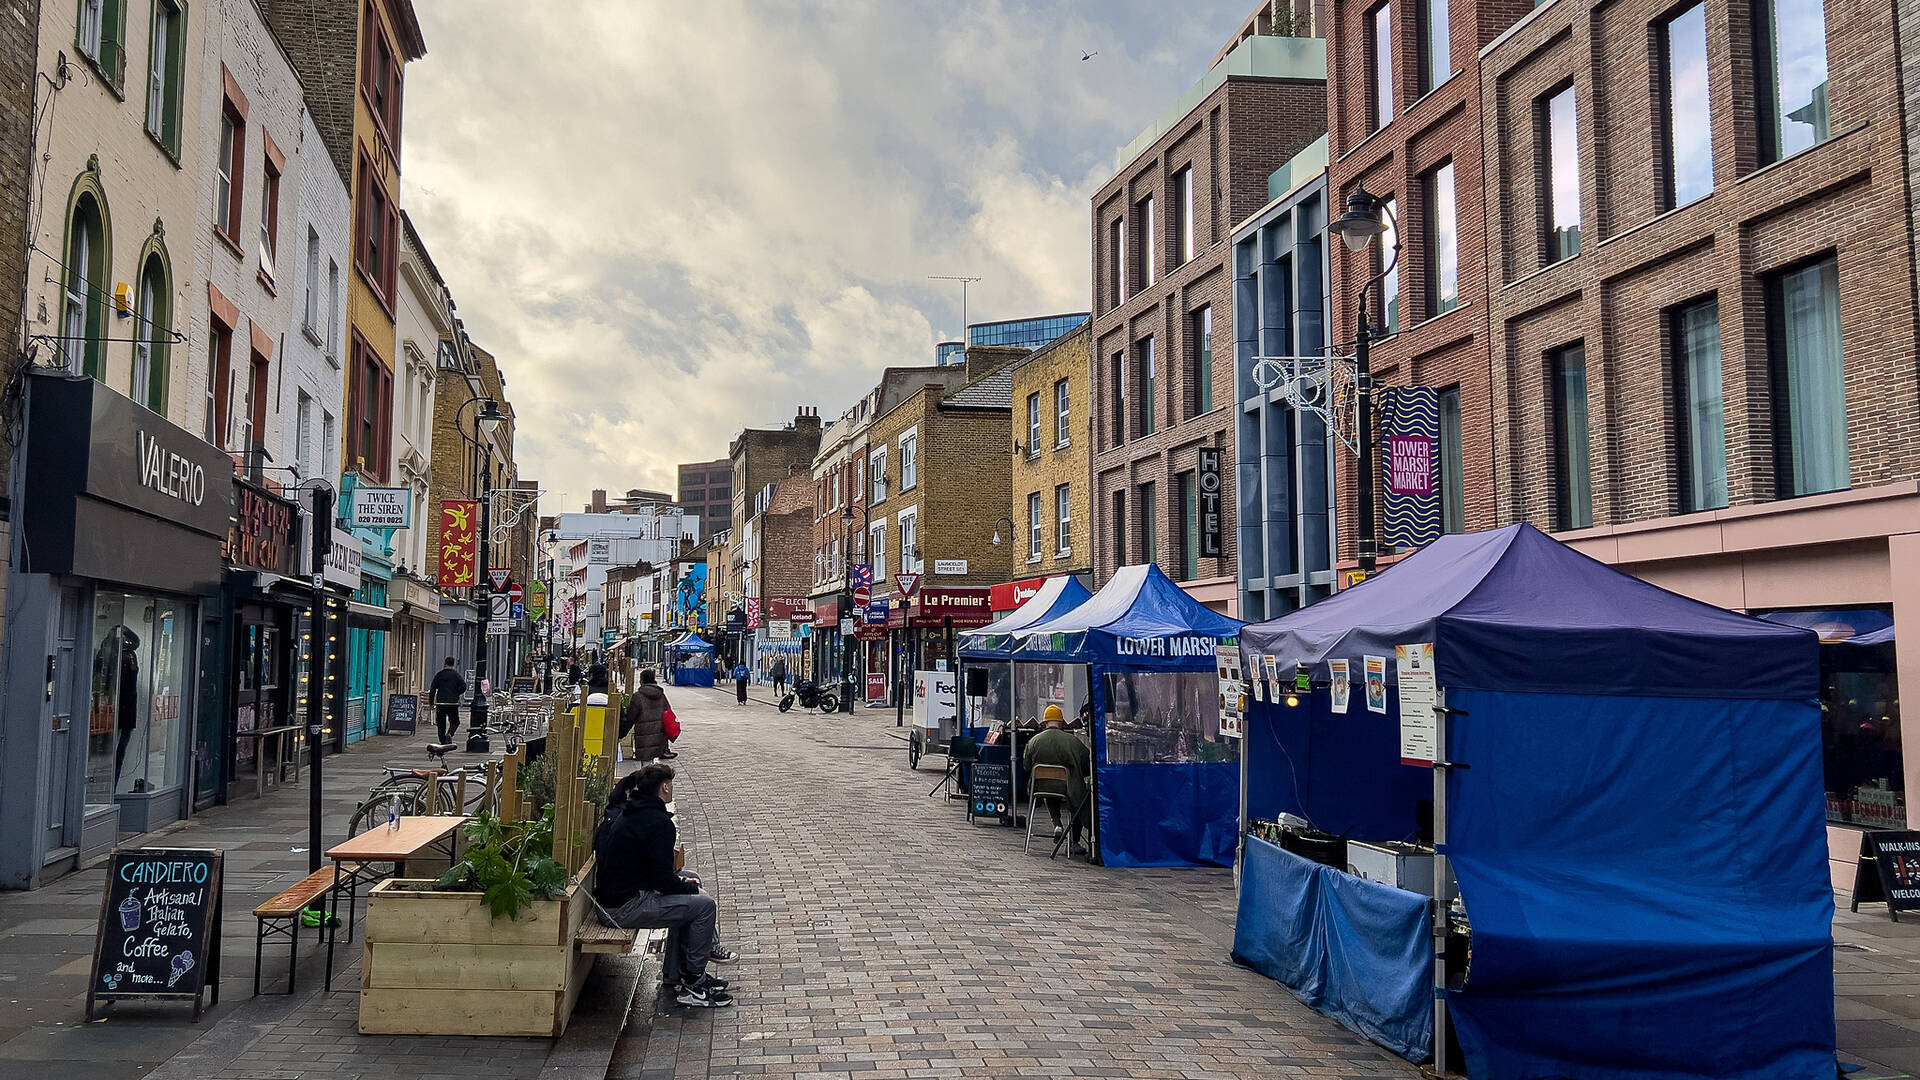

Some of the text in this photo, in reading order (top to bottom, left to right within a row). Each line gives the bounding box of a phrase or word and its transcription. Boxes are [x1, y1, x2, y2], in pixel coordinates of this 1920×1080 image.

[1392, 440, 1429, 457] LOWER
[140, 430, 204, 506] VALERIO
[1393, 457, 1429, 473] MARSH
[1393, 473, 1430, 491] MARKET
[367, 493, 395, 503] TWICE
[1200, 451, 1219, 554] HOTEL
[358, 504, 404, 515] THE SIREN
[924, 595, 938, 606] Le
[941, 595, 985, 606] Premier
[791, 613, 812, 621] Iceland
[1116, 636, 1165, 656] LOWER
[1169, 637, 1217, 656] MARSH
[868, 677, 884, 685] SALE
[935, 681, 957, 694] Fed
[1878, 842, 1920, 852] WALK-INS
[120, 862, 208, 884] CANDIERO
[143, 887, 203, 907] Artisanal
[1890, 888, 1920, 899] WELCO
[146, 906, 185, 924] Italian
[153, 923, 193, 938] Gelato,
[123, 936, 169, 958] Coffee
[116, 962, 135, 973] and
